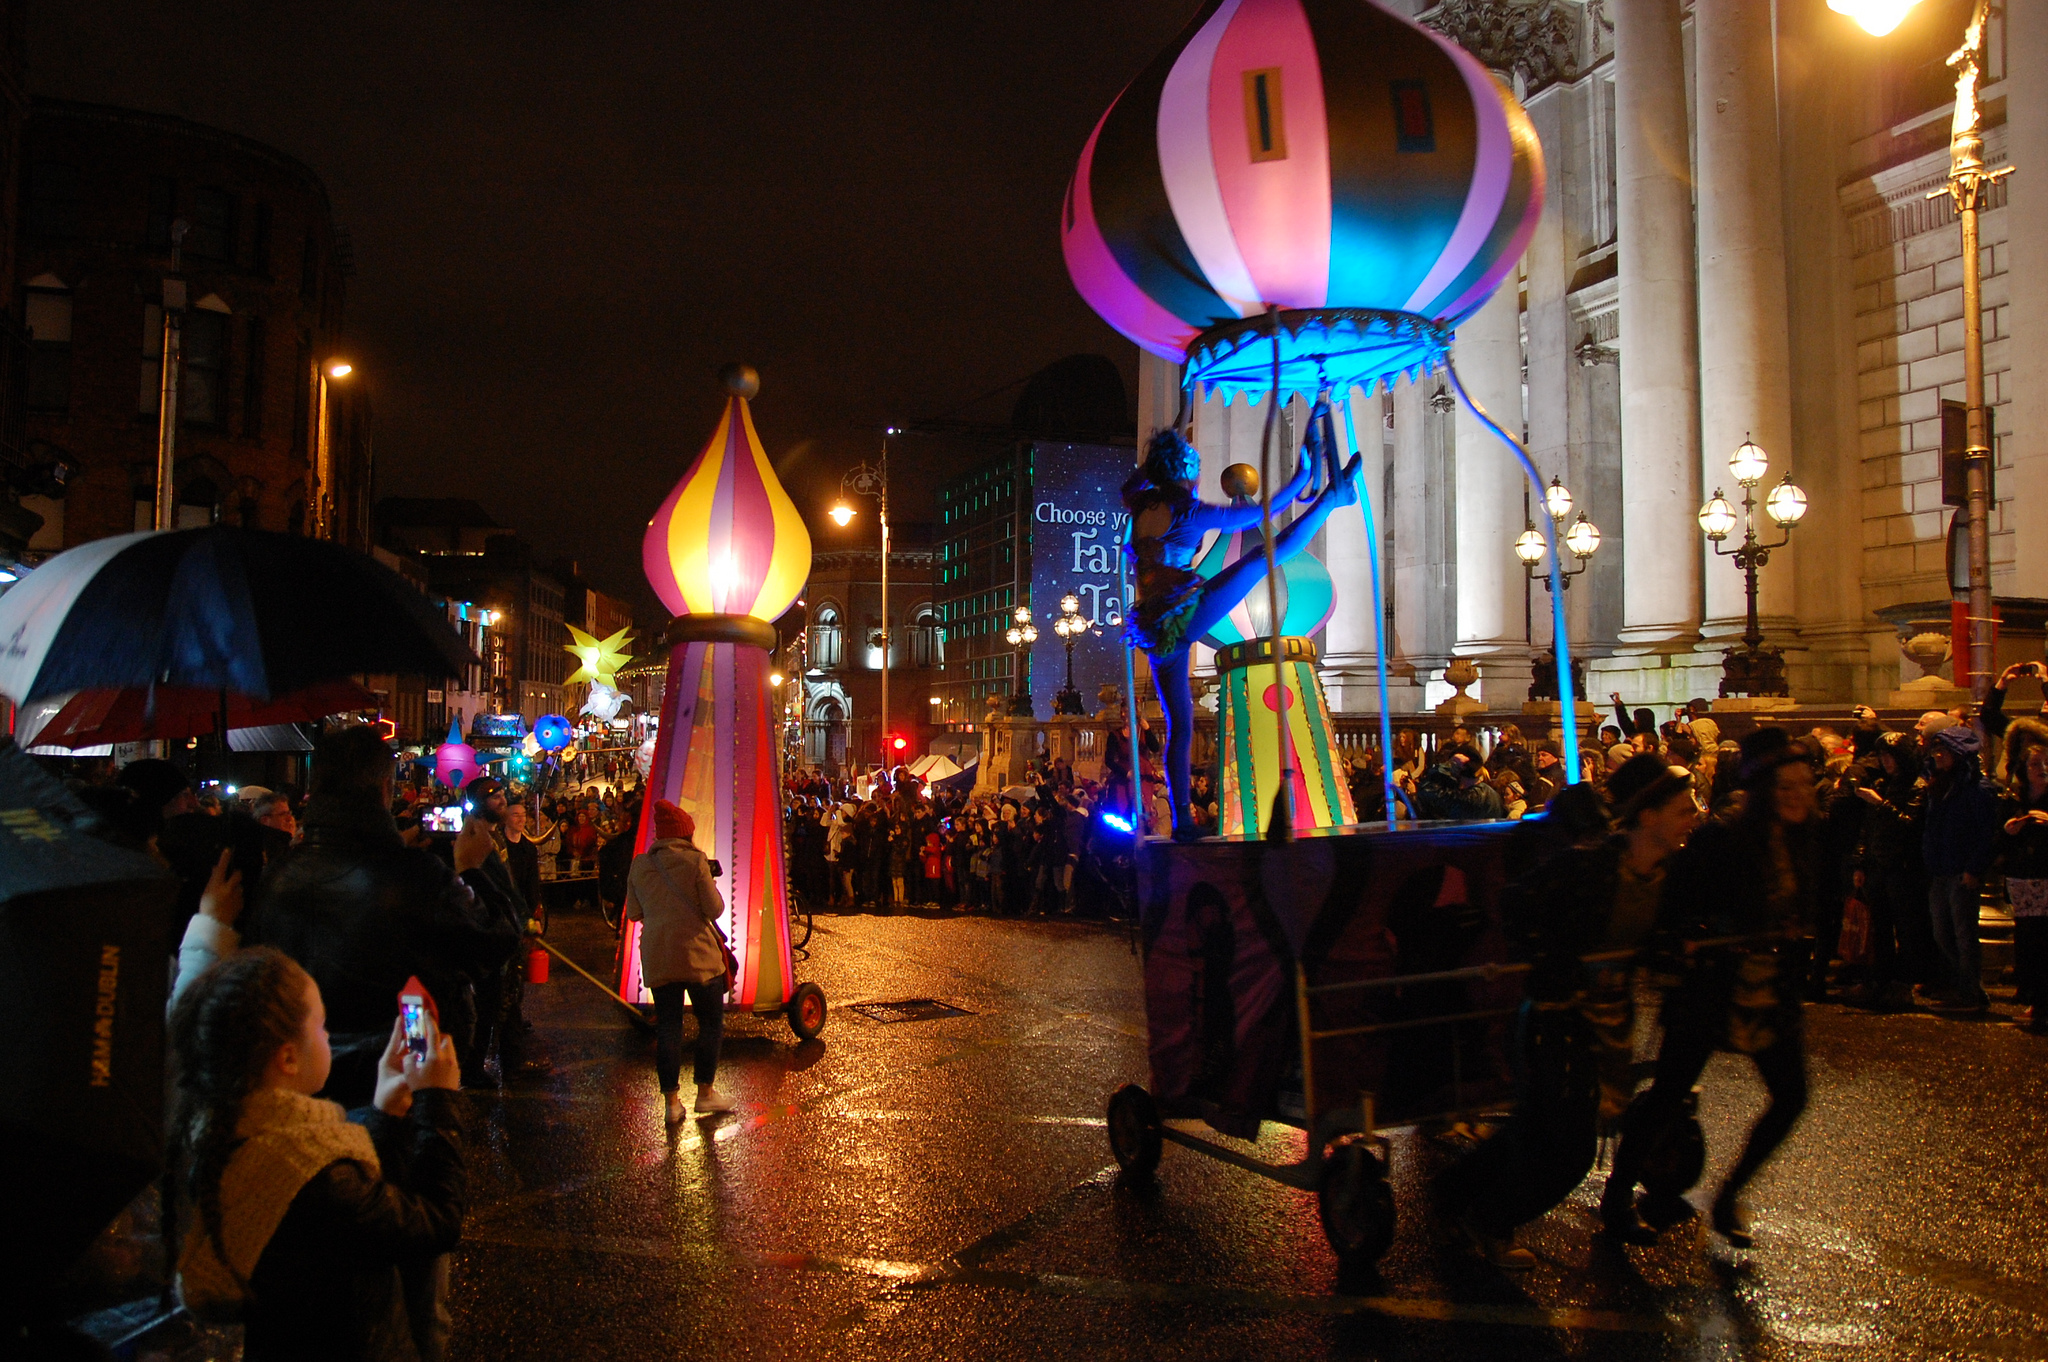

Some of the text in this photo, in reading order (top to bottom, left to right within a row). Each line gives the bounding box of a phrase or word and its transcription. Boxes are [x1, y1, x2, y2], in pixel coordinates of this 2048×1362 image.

[1036, 503, 1106, 525] Choose
[1072, 528, 1134, 575] Fai
[399, 763, 406, 772] P
